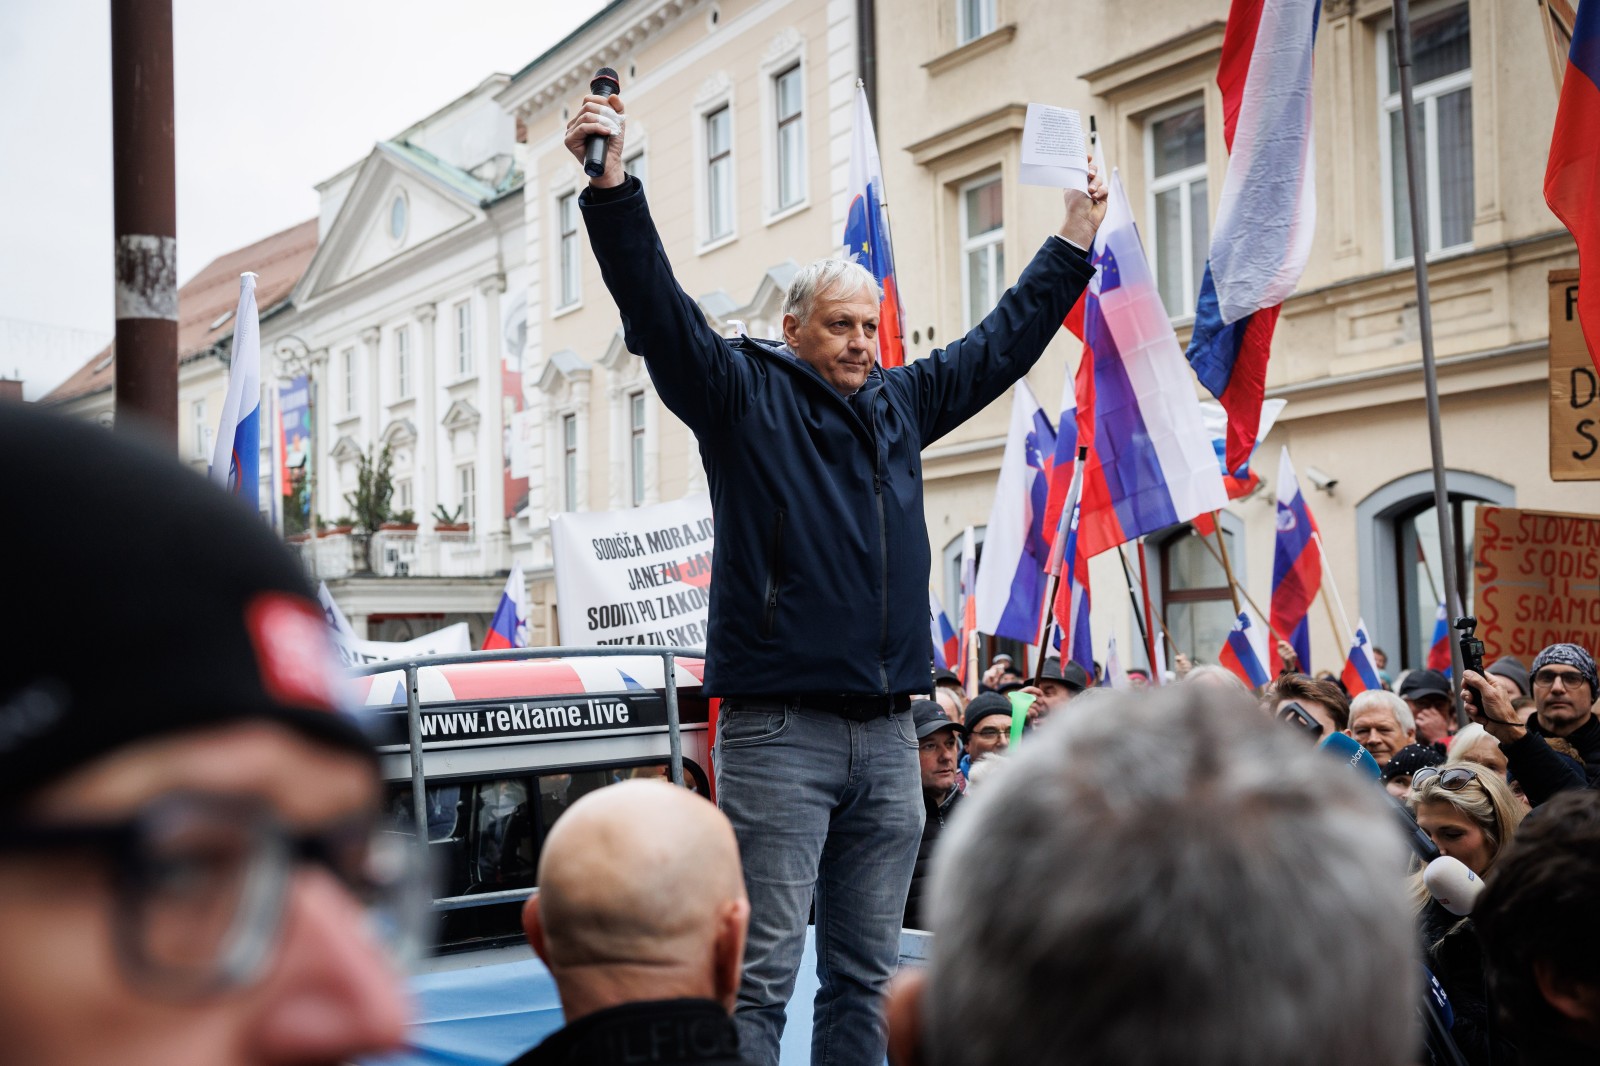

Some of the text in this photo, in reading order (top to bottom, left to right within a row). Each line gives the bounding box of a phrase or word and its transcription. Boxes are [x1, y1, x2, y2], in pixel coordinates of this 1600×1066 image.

[592, 517, 714, 561] SODIŠČA MORAJO
[628, 560, 683, 591] JANEZU
[587, 601, 640, 631] SODITI
[637, 599, 657, 623] PO
[419, 699, 630, 737] www.reklame.live
